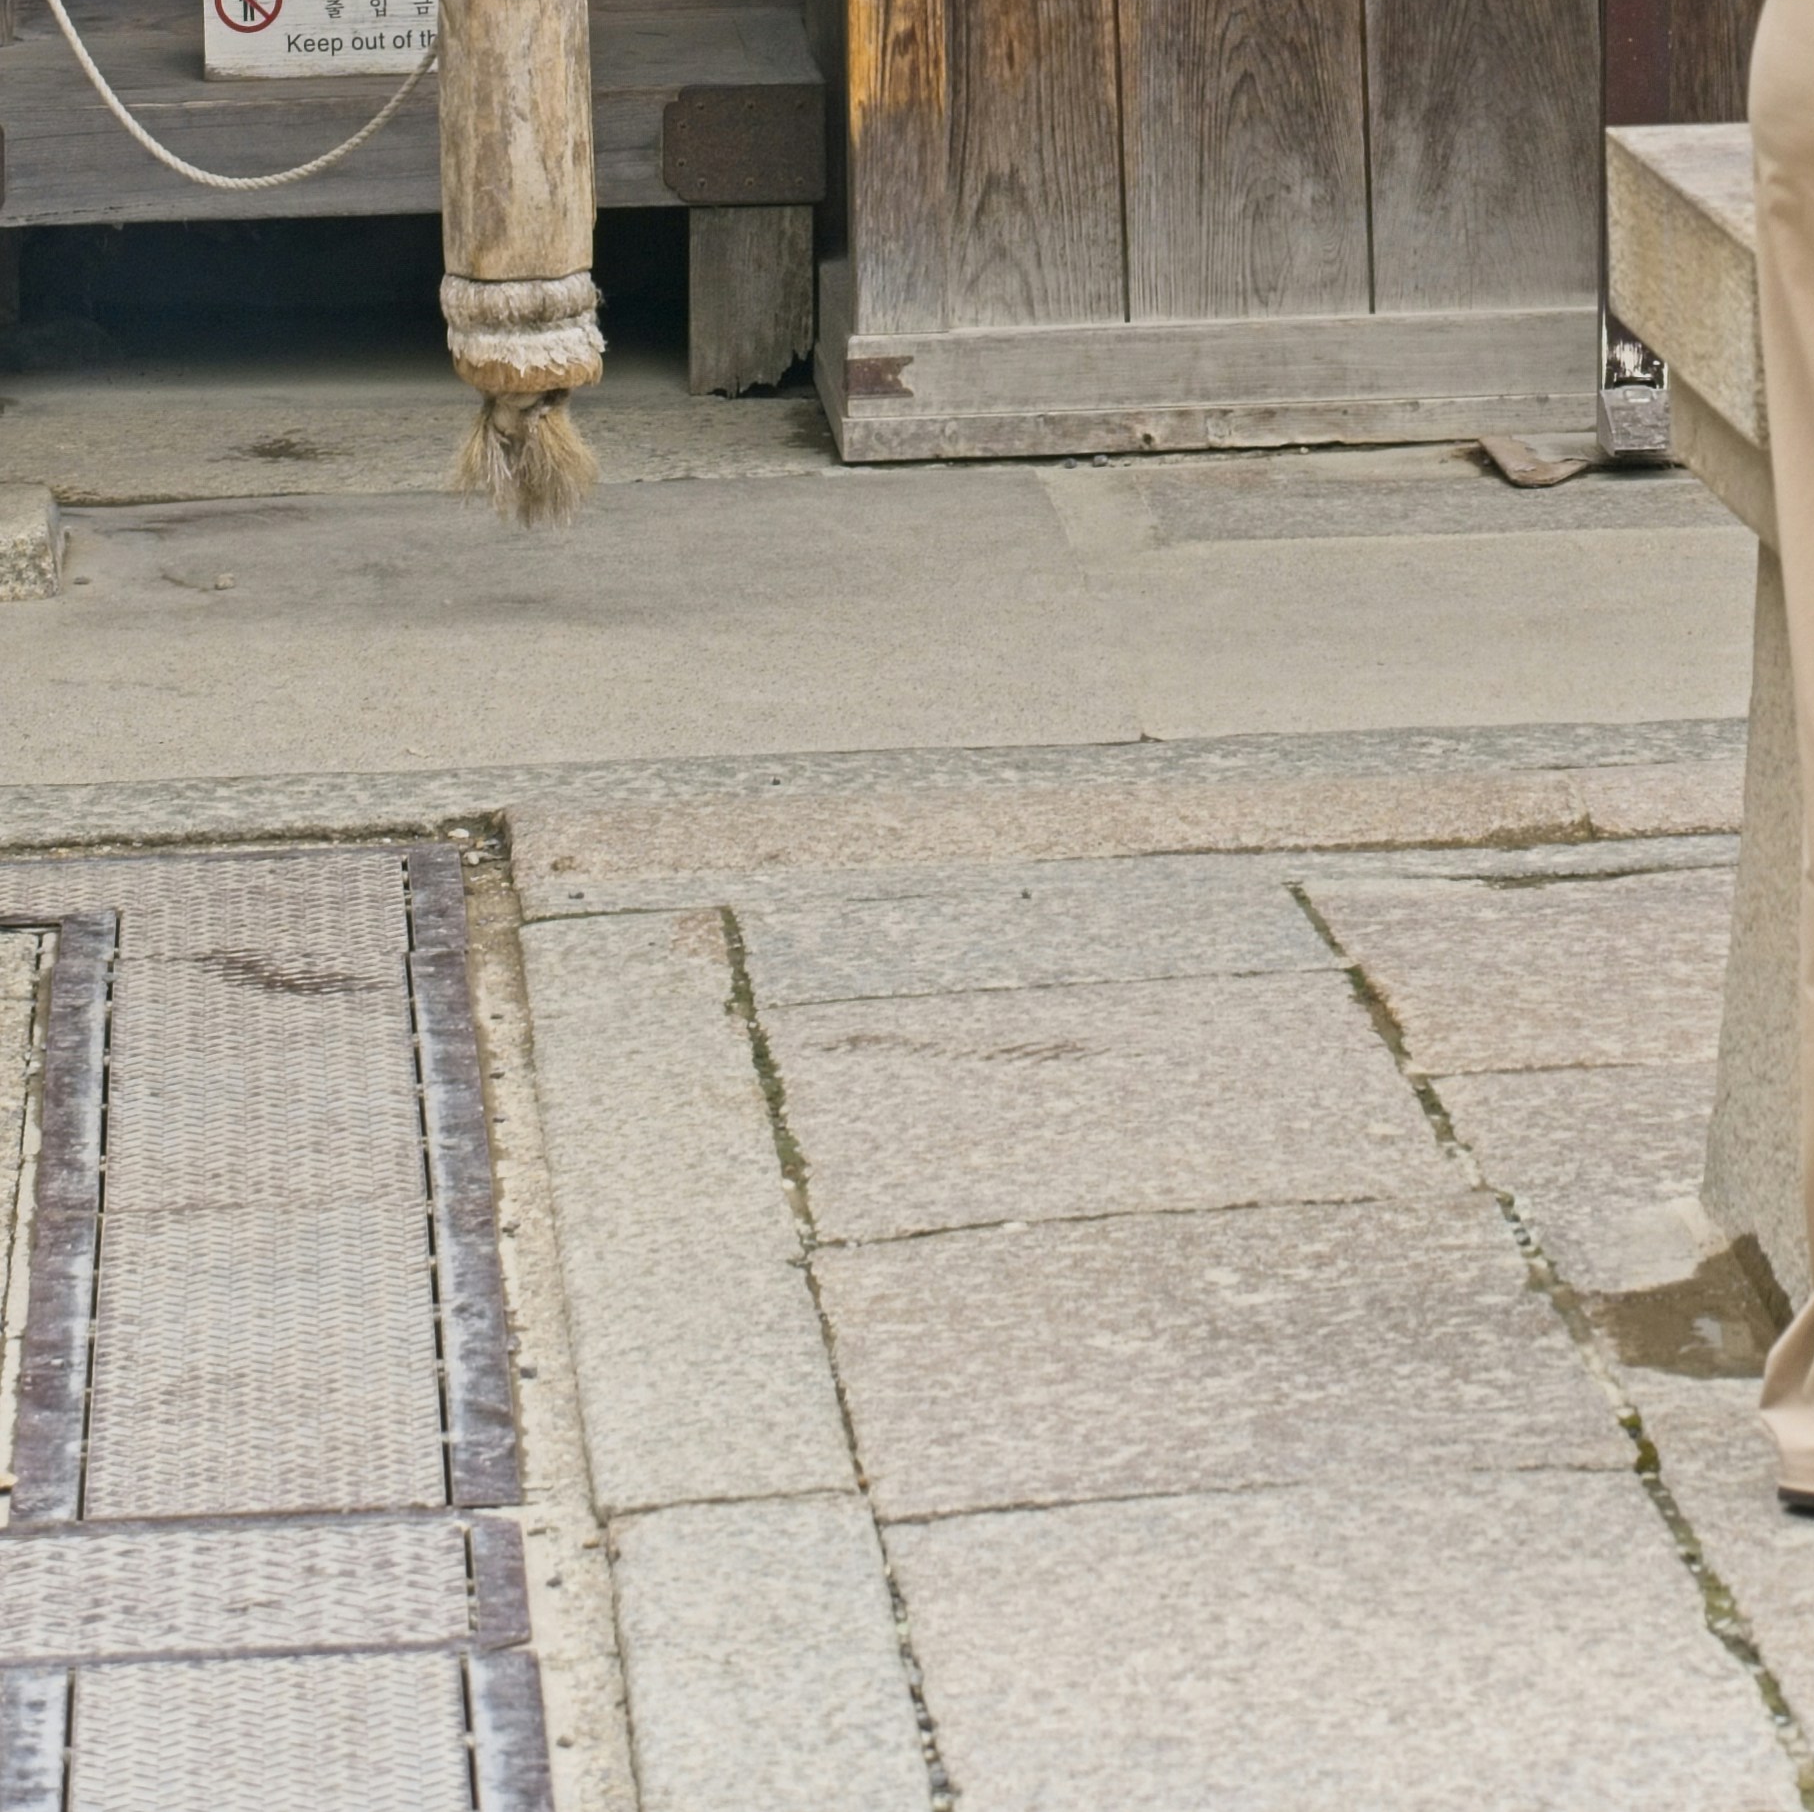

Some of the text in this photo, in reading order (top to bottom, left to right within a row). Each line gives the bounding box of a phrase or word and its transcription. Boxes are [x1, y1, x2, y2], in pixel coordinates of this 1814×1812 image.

[287, 33, 343, 56] Keep
[351, 31, 385, 52] out
[392, 29, 412, 50] of
